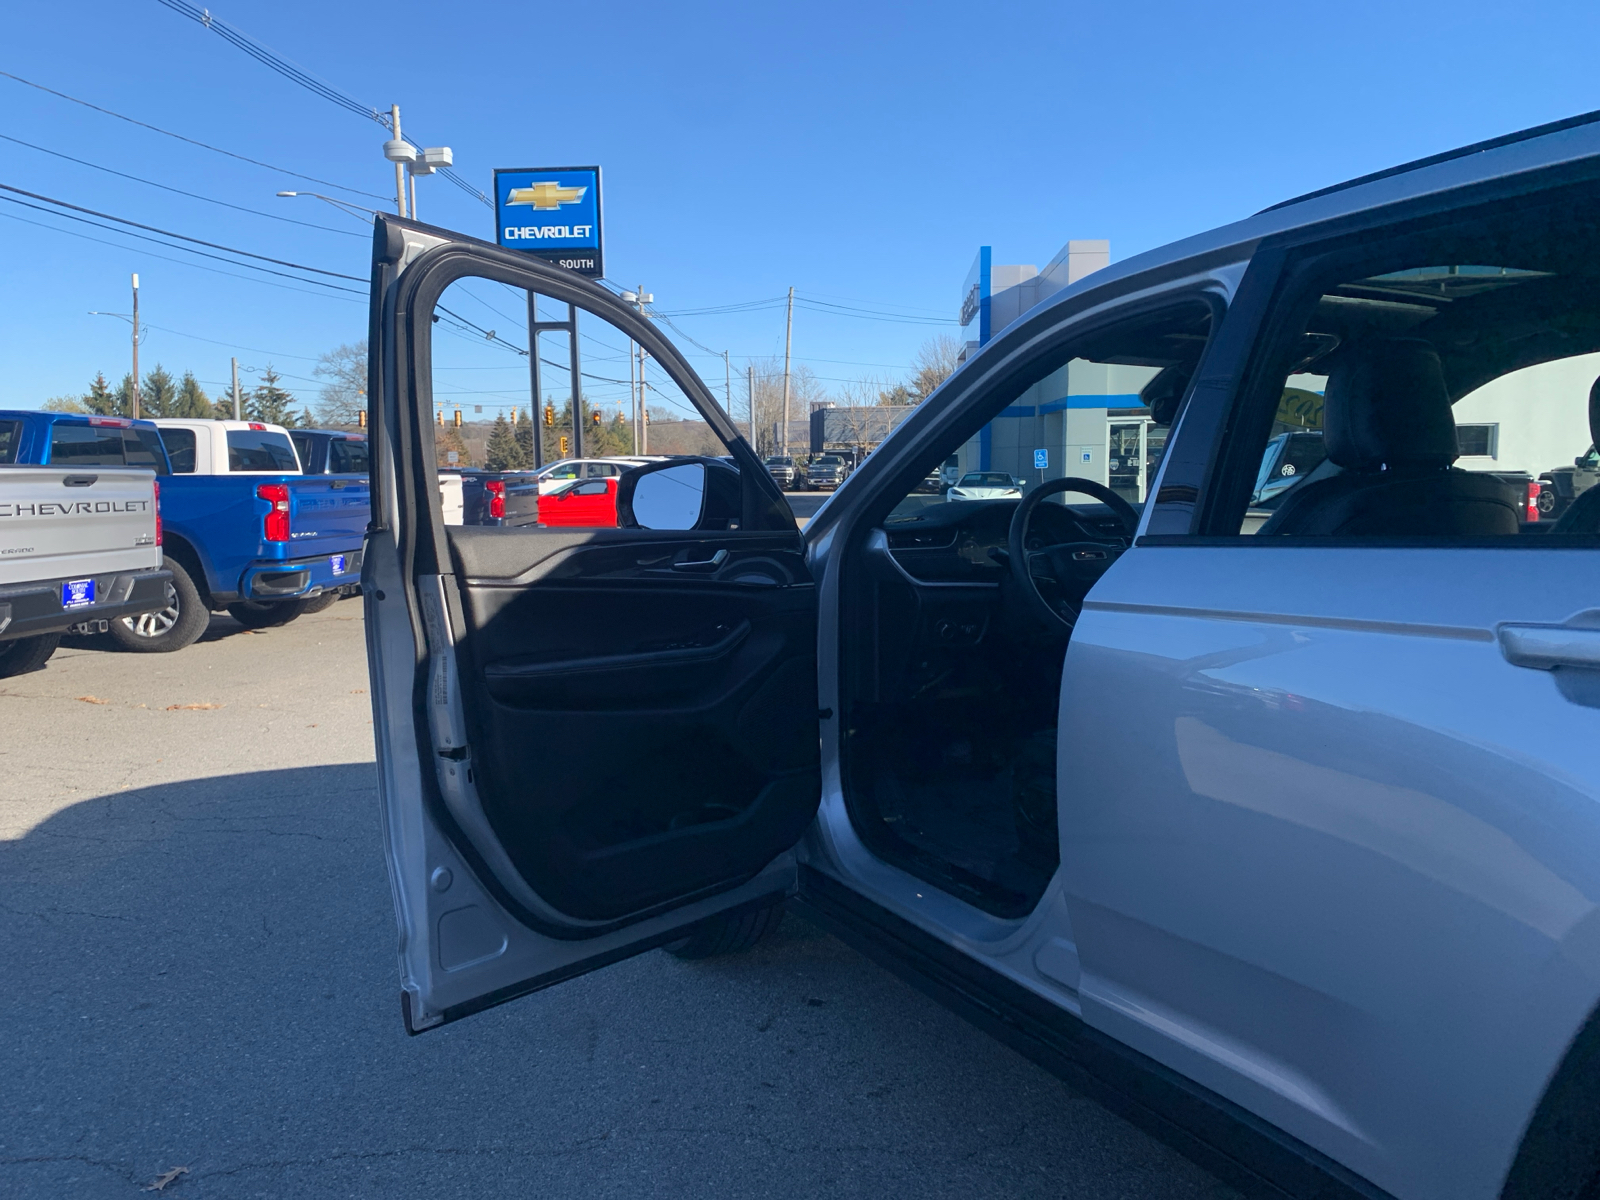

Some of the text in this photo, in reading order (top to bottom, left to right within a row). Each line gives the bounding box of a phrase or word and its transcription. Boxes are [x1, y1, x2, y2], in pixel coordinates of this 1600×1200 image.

[504, 225, 592, 240] CHEVROLET
[559, 259, 594, 269] SOUTH
[0, 500, 149, 517] CHEVROLET
